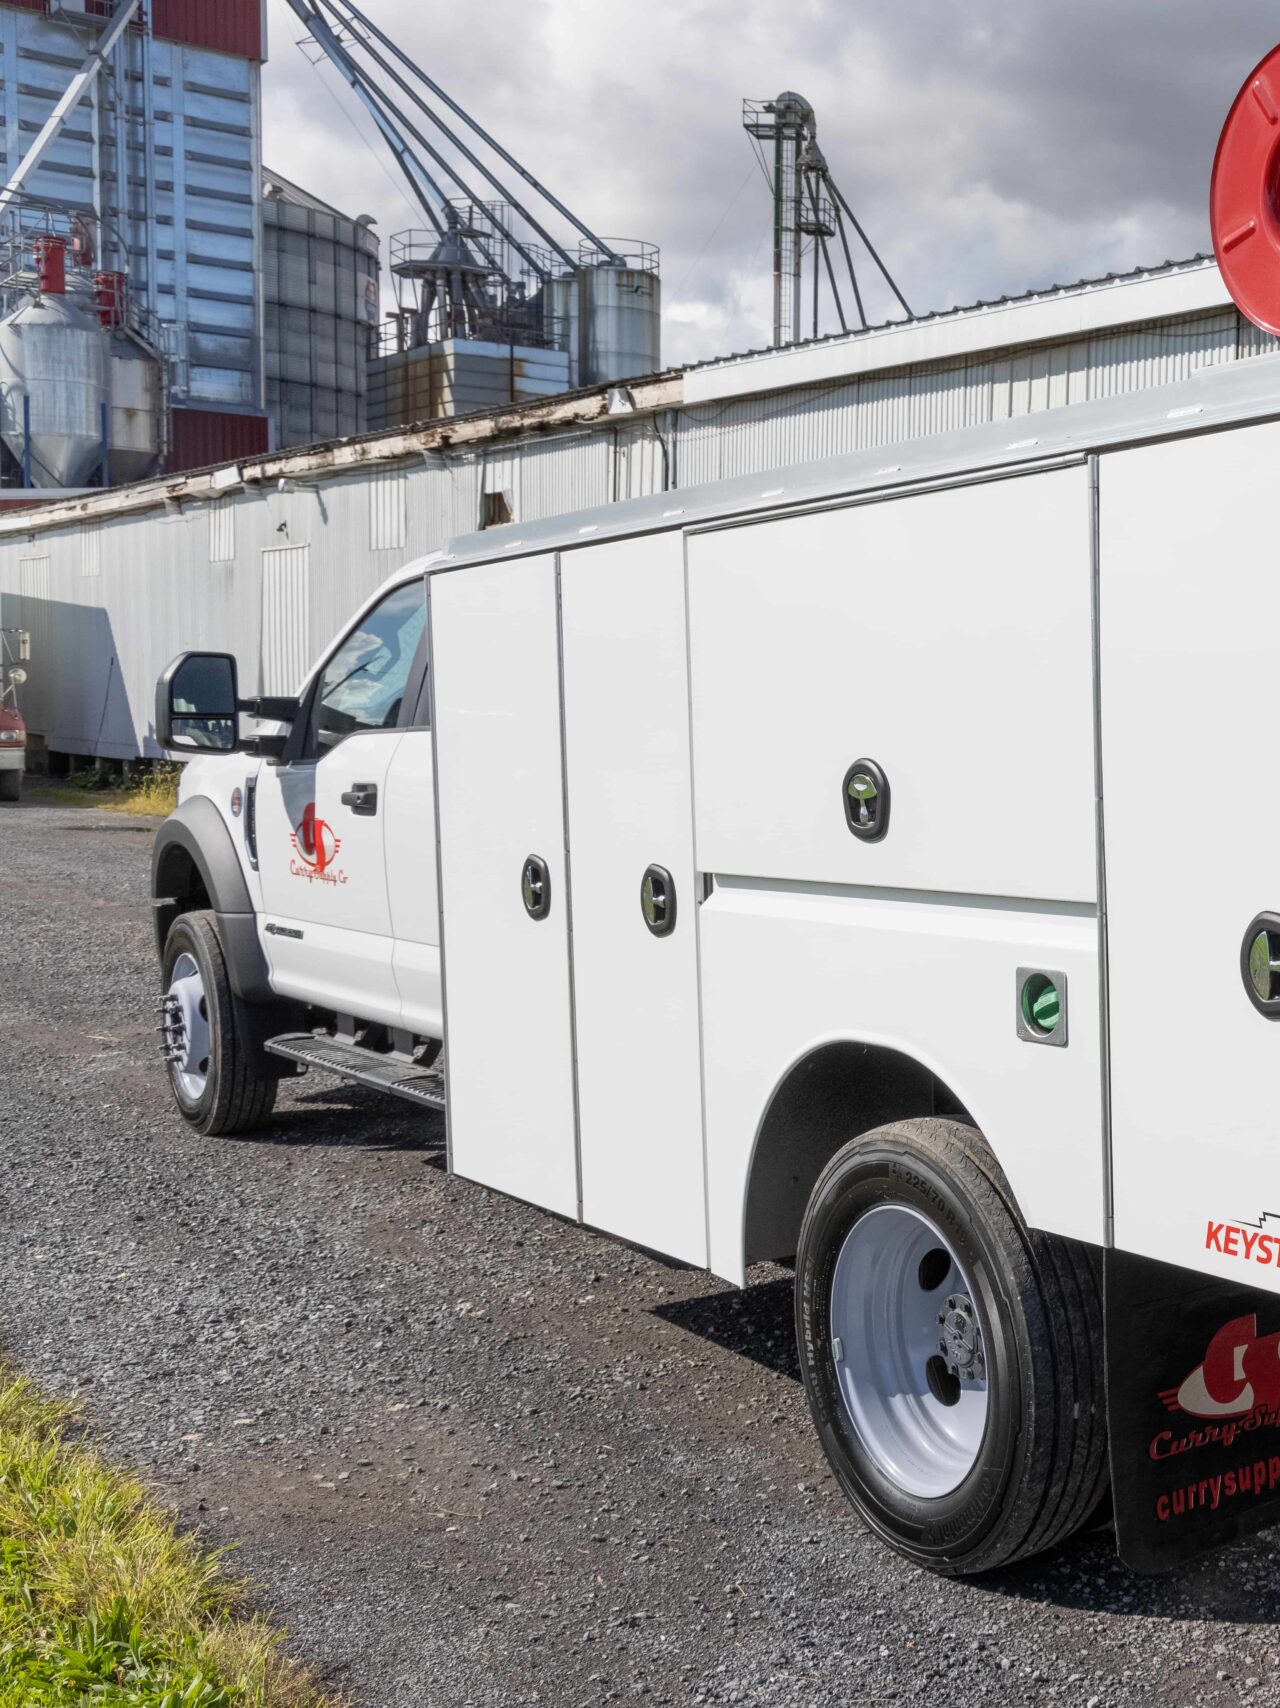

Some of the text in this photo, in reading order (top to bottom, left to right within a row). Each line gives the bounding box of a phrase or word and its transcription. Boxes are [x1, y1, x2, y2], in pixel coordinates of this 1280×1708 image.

[289, 859, 314, 883] Curry
[905, 1171, 946, 1212] 225/70
[802, 1301, 816, 1367] Hybrid
[1148, 1419, 1241, 1461] Curry
